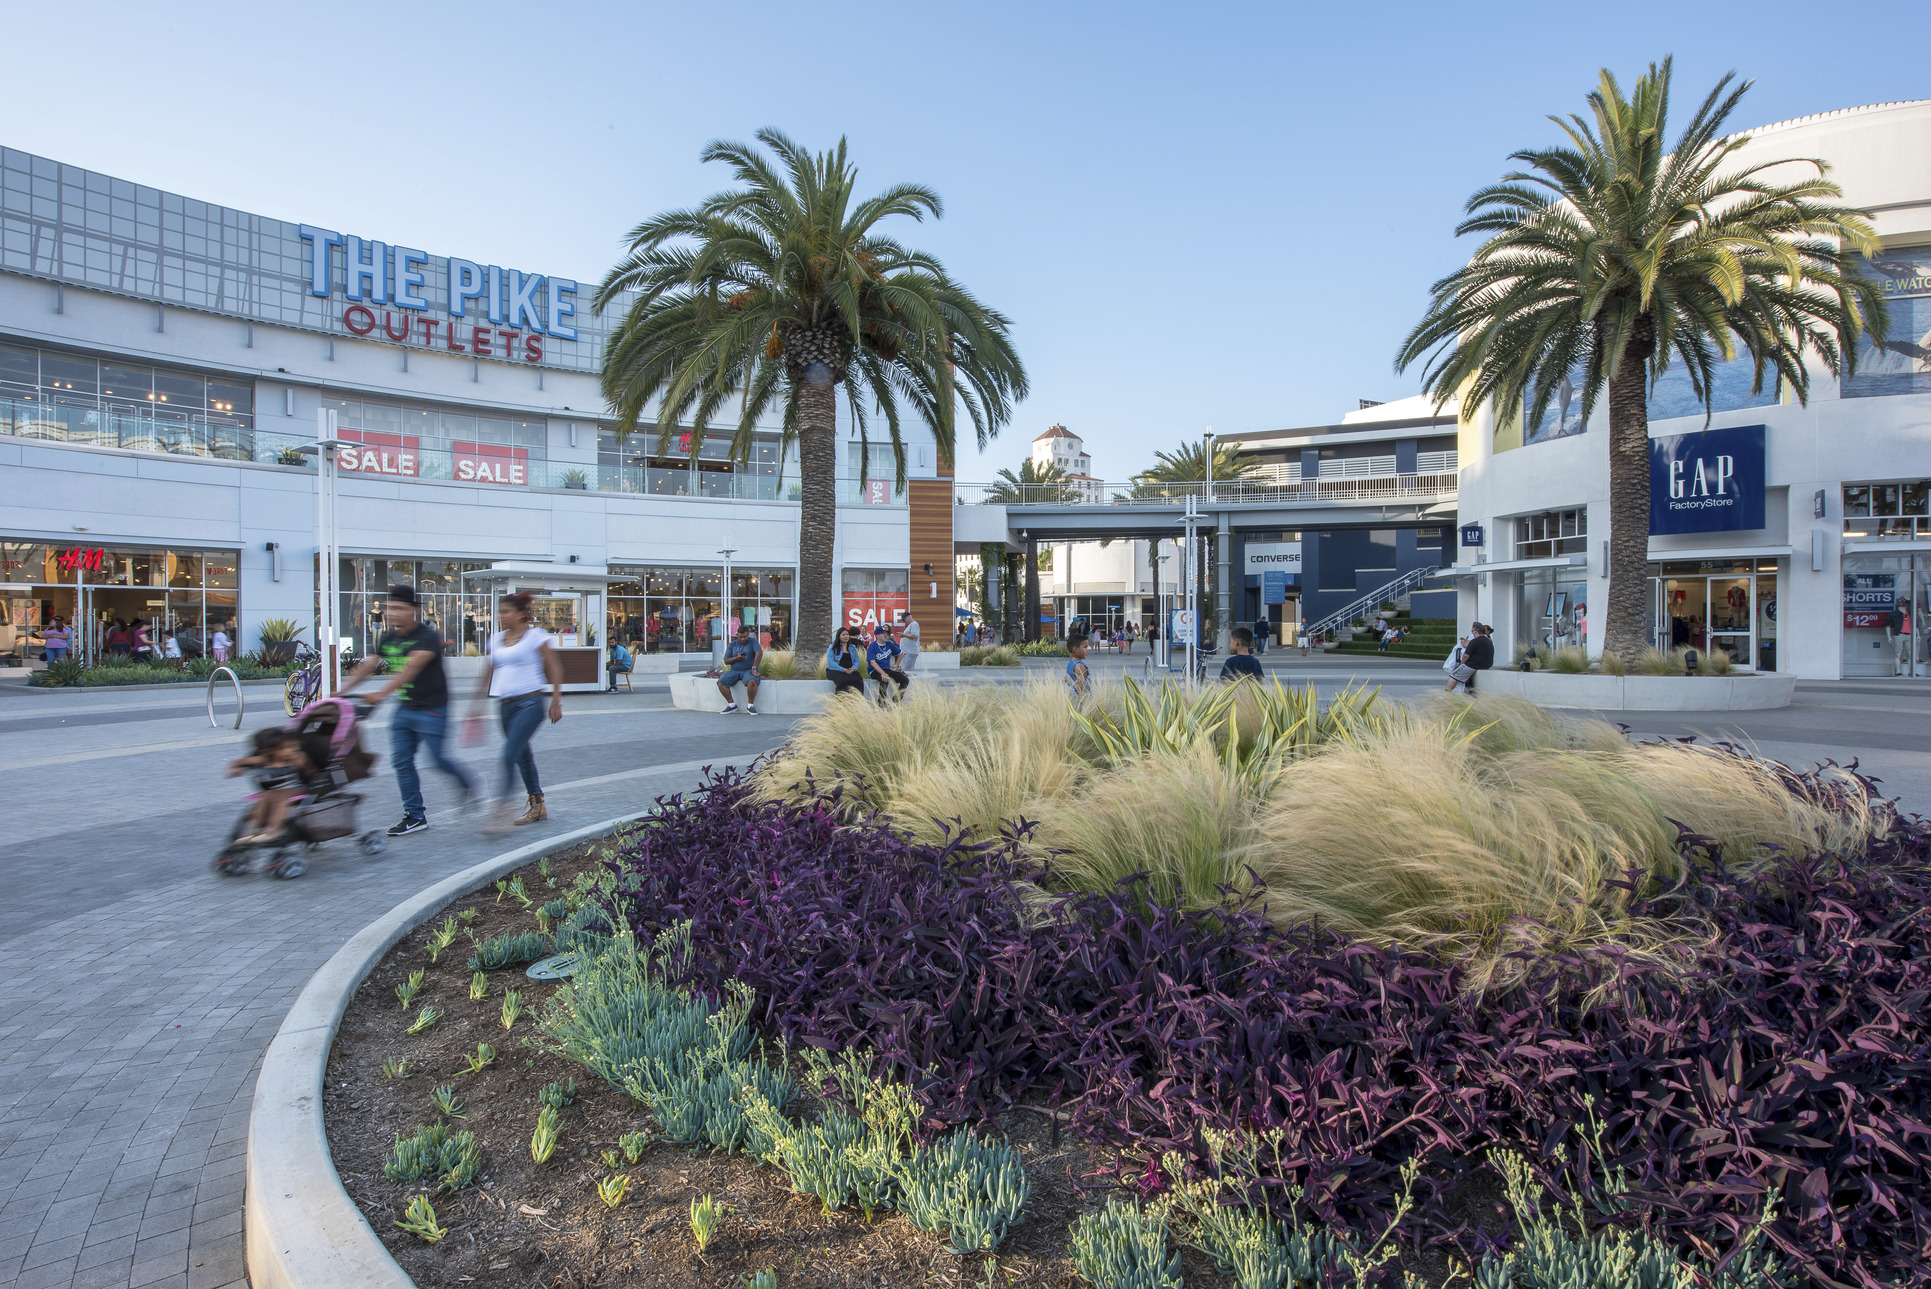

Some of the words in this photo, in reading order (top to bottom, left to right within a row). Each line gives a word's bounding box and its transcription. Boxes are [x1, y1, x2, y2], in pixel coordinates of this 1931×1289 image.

[299, 223, 428, 311] THE
[449, 256, 578, 341] PIKE
[344, 305, 543, 362] OUTLETS
[340, 448, 414, 475] SALE
[458, 459, 524, 484] SALE
[1669, 455, 1734, 499] GAP
[1669, 498, 1733, 511] FactoryStore
[57, 548, 104, 571] H&M
[1250, 553, 1301, 563] CONVERSE
[1701, 561, 1713, 569] 55
[119, 573, 130, 581] 37
[848, 608, 906, 627] SALE
